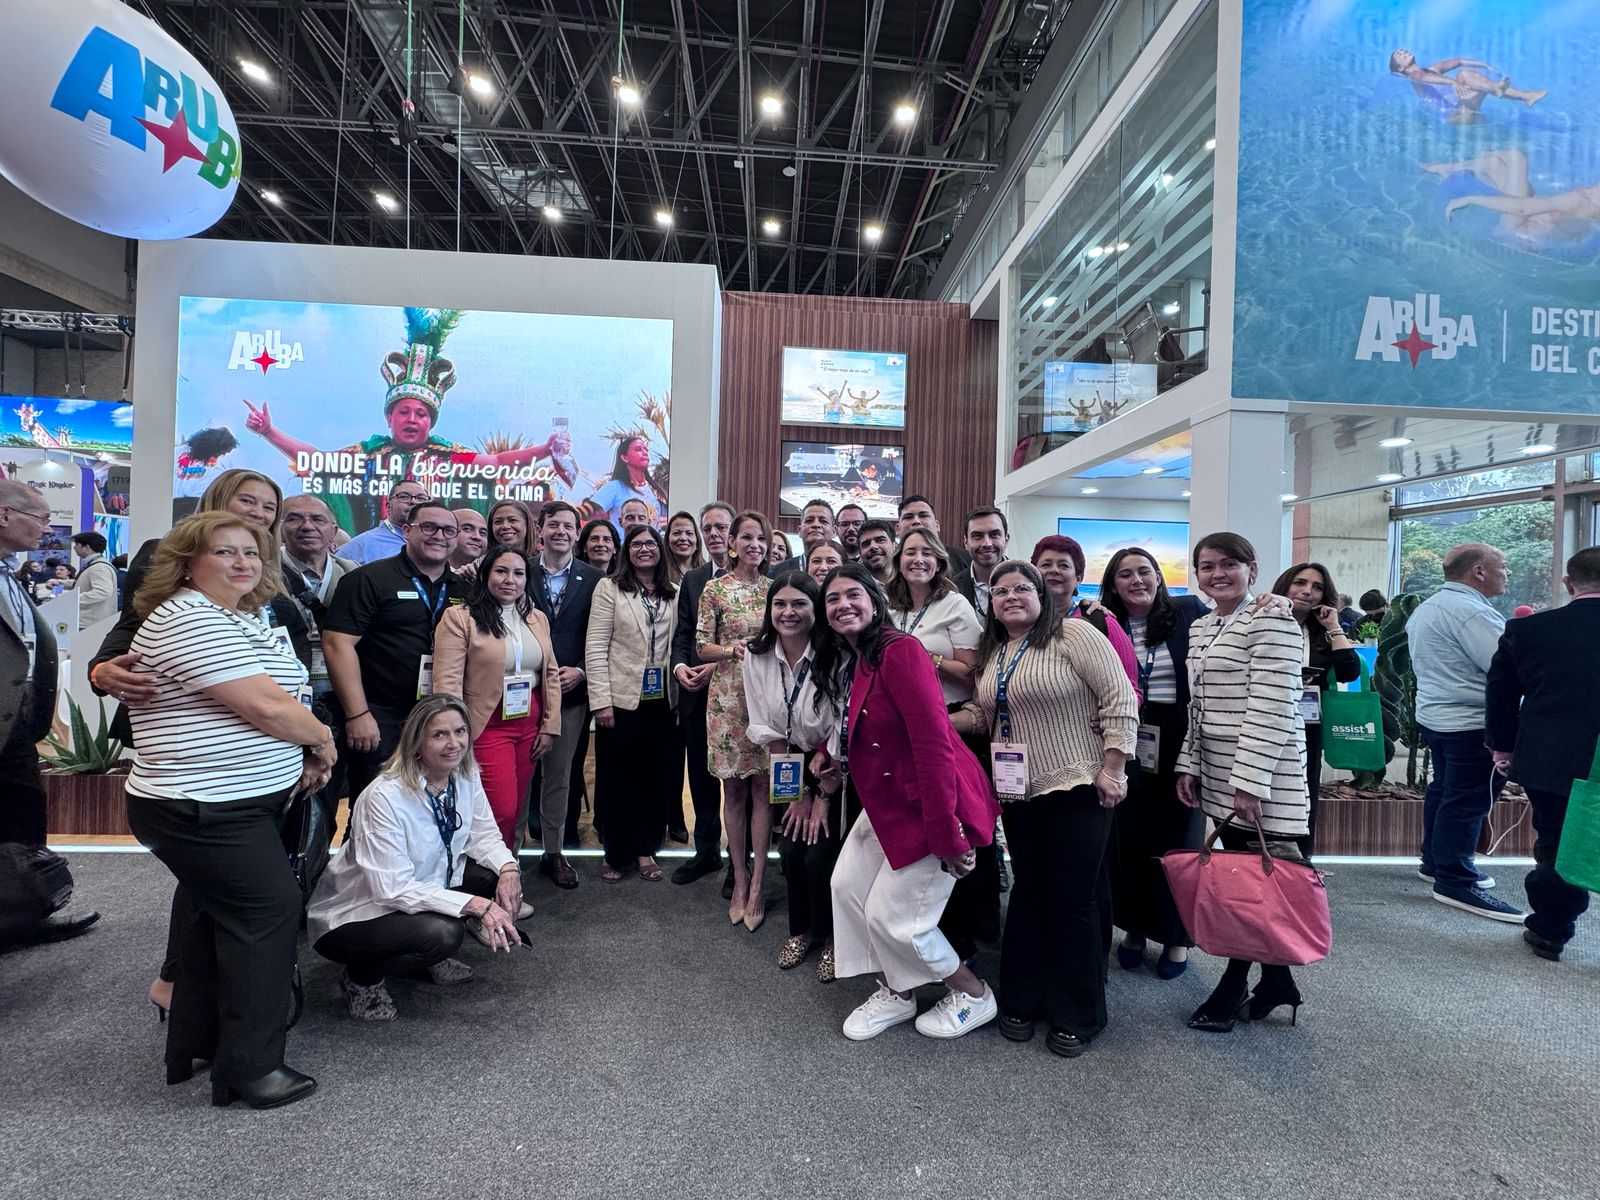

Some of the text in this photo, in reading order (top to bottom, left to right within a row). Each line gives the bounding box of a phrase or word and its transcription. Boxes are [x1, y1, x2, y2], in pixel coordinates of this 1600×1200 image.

[50, 26, 241, 190] ARUB
[1355, 293, 1478, 363] ARUBA
[227, 329, 304, 371] ARUBA
[1530, 344, 1578, 374] DEL
[297, 450, 557, 481] DONDE LA bienvenida
[302, 477, 323, 494] ES
[329, 474, 362, 496] MÁS
[431, 481, 462, 499] QUE
[467, 483, 488, 500] EL
[494, 484, 544, 502] CLIMA
